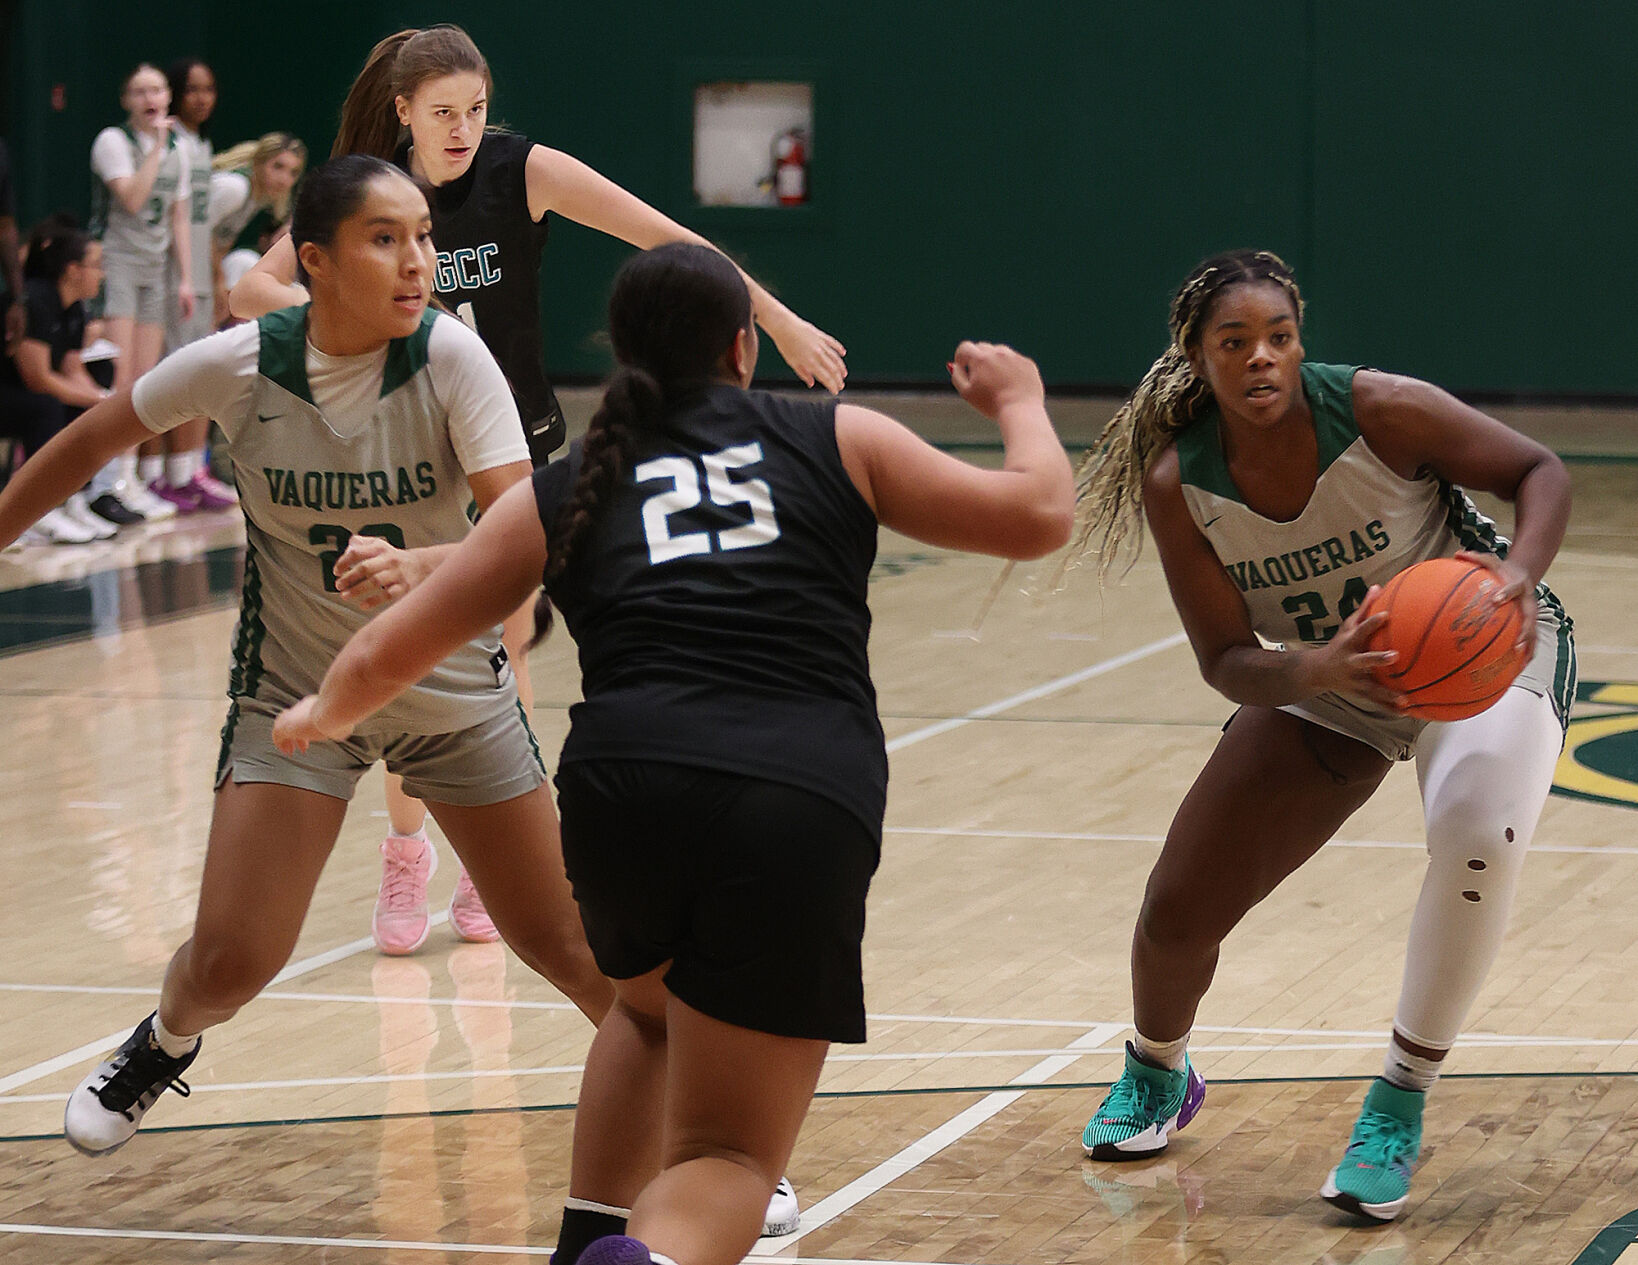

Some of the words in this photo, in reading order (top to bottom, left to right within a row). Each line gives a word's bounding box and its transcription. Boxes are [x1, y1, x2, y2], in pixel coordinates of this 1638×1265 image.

[431, 242, 502, 293] GCC
[263, 461, 437, 512] VAQUERAS
[634, 441, 781, 566] 25
[1225, 519, 1391, 593] VAQUERAS
